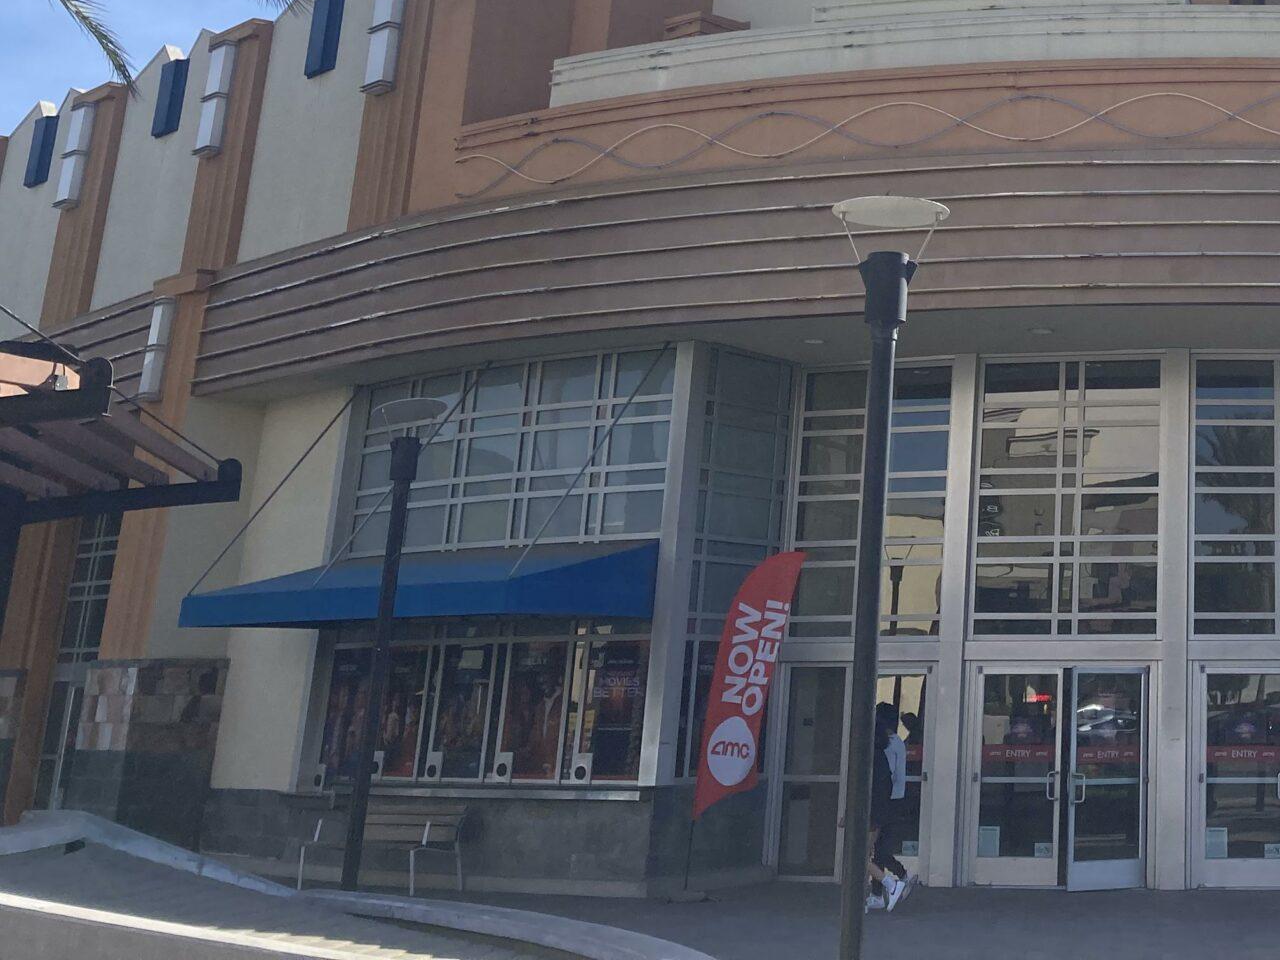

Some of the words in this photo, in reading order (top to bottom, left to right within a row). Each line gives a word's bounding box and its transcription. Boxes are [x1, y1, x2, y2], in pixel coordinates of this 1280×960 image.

[721, 601, 762, 704] NOW
[741, 599, 790, 716] OPEN!
[711, 740, 750, 760] amc
[1005, 749, 1031, 758] ENTRY
[1096, 751, 1120, 759] ENTRY
[1231, 749, 1258, 759] ENTRY
